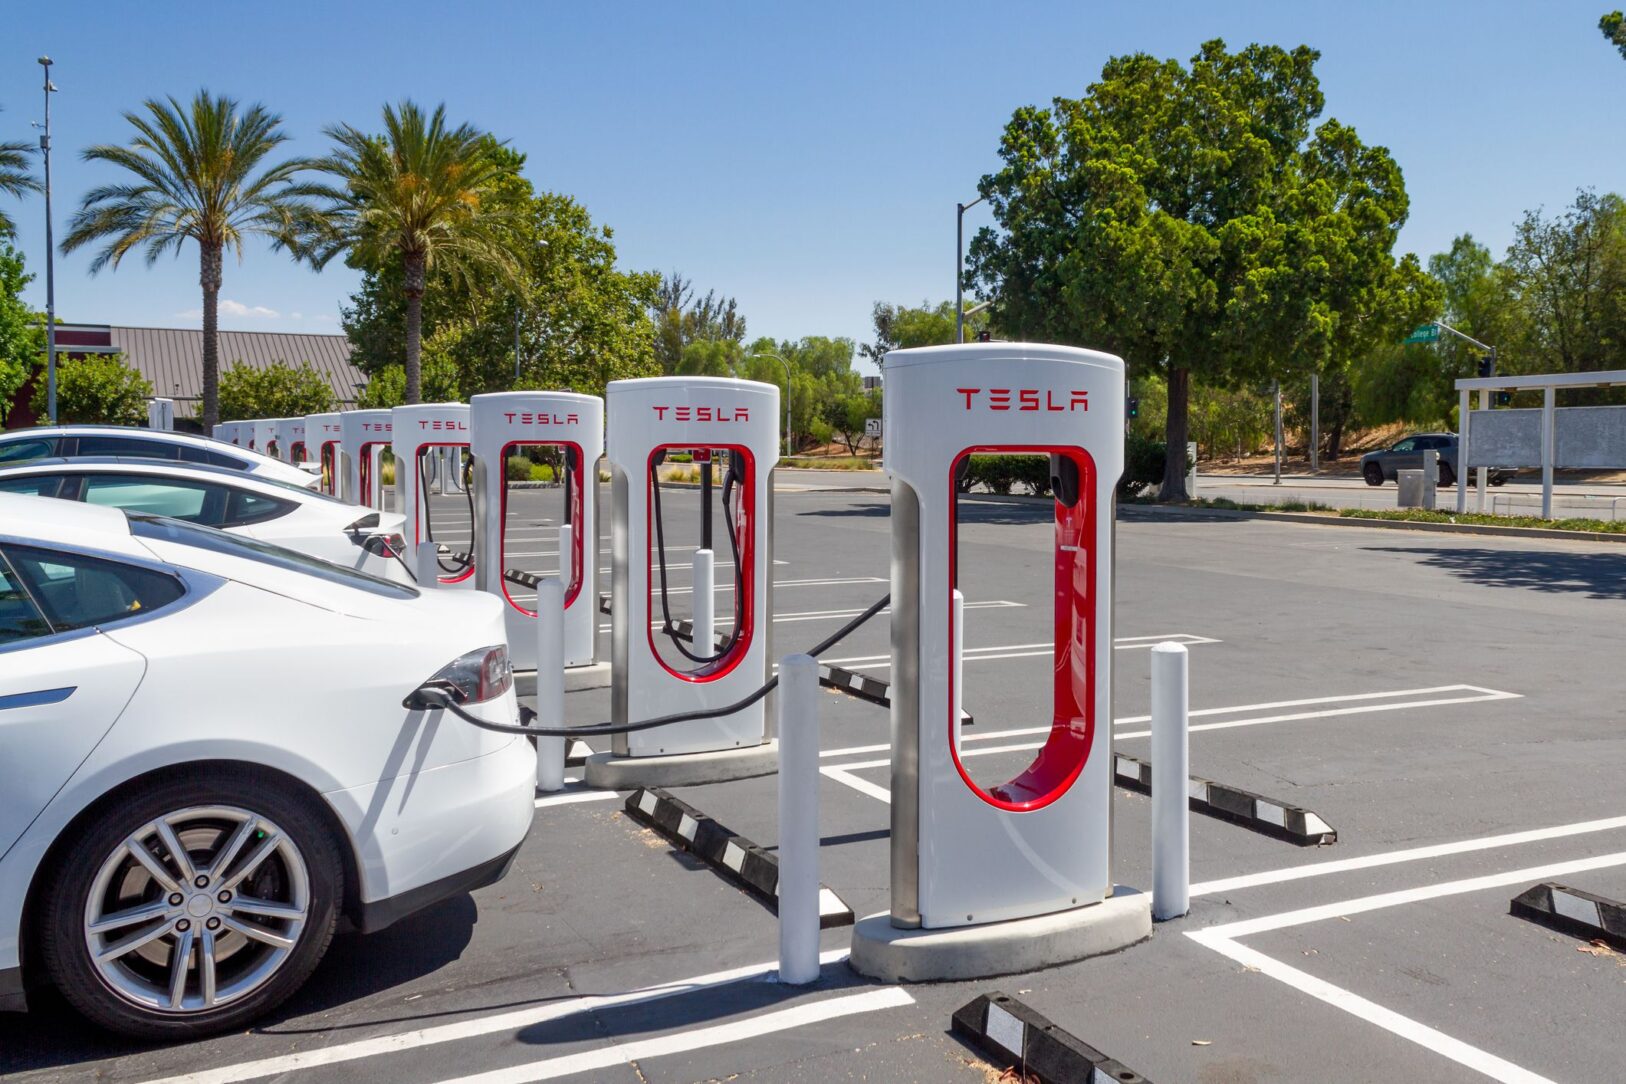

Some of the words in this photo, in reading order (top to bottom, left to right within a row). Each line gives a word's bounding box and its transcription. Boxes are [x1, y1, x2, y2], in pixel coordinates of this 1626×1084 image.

[957, 388, 1089, 412] TESLA
[505, 413, 578, 424] TESLA
[653, 406, 749, 422] TESLA
[362, 423, 392, 431] TES
[419, 421, 467, 430] TESL
